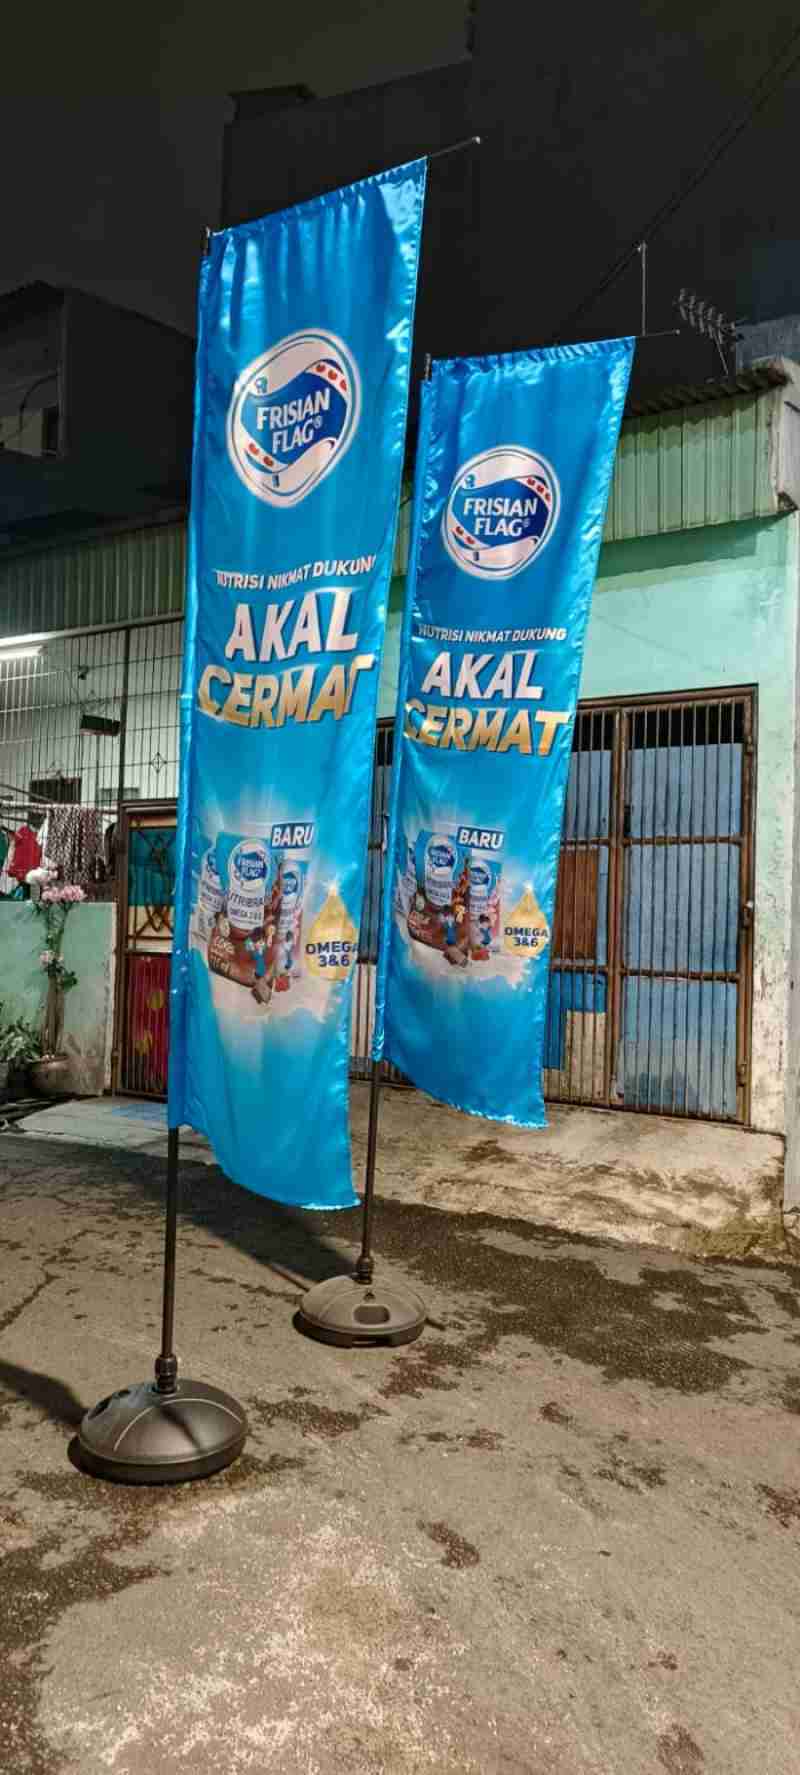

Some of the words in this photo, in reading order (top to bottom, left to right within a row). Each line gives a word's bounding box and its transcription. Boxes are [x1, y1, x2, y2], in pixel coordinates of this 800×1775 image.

[256, 388, 331, 430] FRISIAN
[463, 497, 538, 517] FRISIAN
[312, 554, 377, 577] DUKUN
[225, 587, 359, 662] AKAL
[464, 629, 511, 643] NIKMAT
[512, 627, 567, 642] DUKUNG
[421, 650, 544, 699] AKAL
[198, 654, 375, 728] CERMAT
[404, 698, 569, 756] CERMAT
[272, 824, 315, 848] BARU
[458, 829, 504, 849] BARU
[504, 926, 549, 937] OMEGA
[513, 937, 539, 948] 3&6
[319, 953, 350, 967] 3&6
